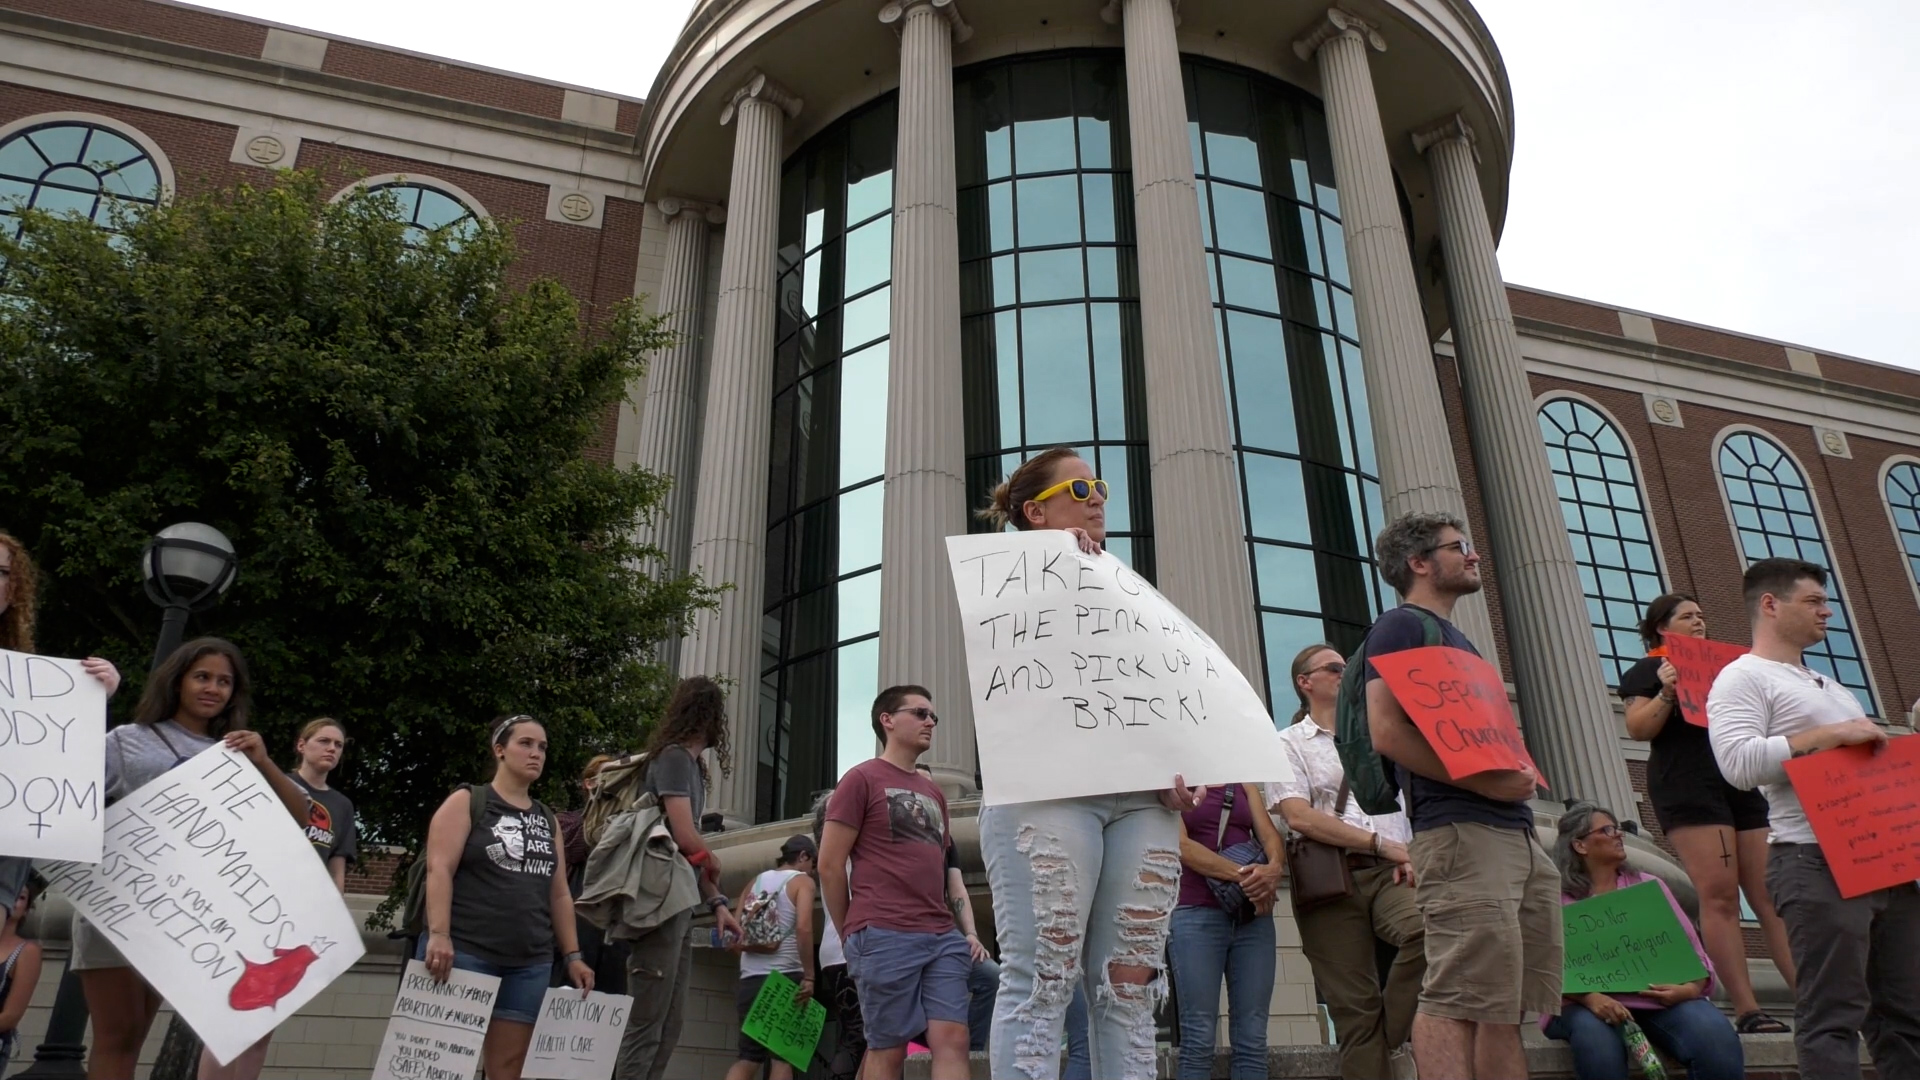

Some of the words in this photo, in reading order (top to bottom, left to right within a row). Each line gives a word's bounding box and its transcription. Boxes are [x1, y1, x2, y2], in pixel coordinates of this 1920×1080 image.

[960, 550, 1104, 598] TAKE
[980, 609, 1057, 649] THE
[1071, 652, 1156, 686] PICK
[1162, 649, 1191, 675] UP
[1206, 657, 1219, 679] A
[1063, 689, 1207, 730] BRICK!
[202, 752, 272, 821] THE
[527, 839, 552, 854] ARE
[105, 808, 177, 866] TALE
[167, 874, 185, 887] is
[183, 887, 213, 917] not
[211, 917, 236, 943] an
[141, 783, 295, 949] HANDMAID'S
[524, 859, 554, 877] NINE
[40, 860, 136, 941] MANUAL
[102, 845, 237, 979] STRUCTION
[1579, 914, 1605, 933] Do
[1605, 907, 1628, 926] Not
[1592, 941, 1620, 962] Your
[1620, 931, 1672, 958] Religion
[397, 996, 445, 1019] ABORTION
[546, 997, 606, 1023] ABORTION
[609, 1007, 624, 1026] IS
[535, 1033, 566, 1052] HEALTH
[571, 1035, 595, 1053] CARE
[395, 1057, 421, 1074] SAFE
